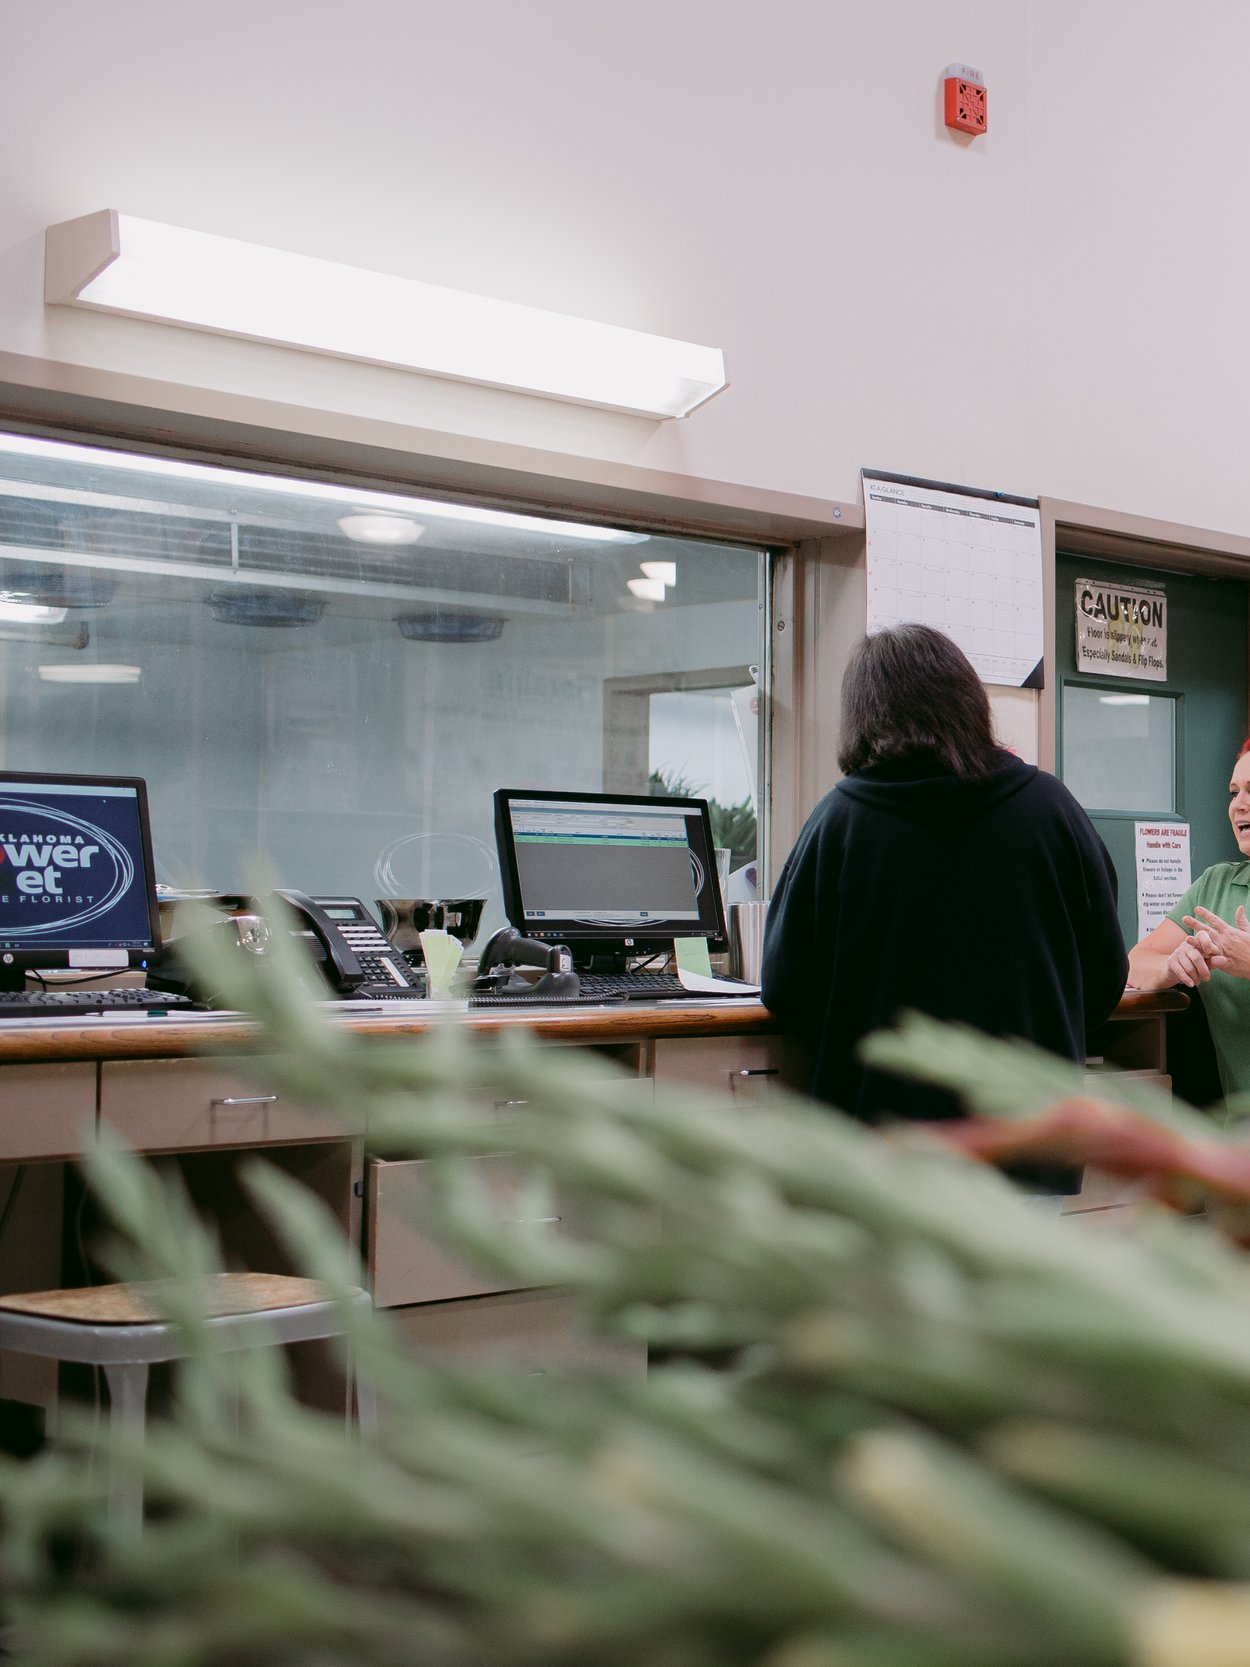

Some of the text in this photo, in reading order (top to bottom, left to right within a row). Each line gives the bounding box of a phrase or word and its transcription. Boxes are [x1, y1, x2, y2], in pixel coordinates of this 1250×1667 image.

[962, 68, 981, 80] FIRE
[1081, 589, 1163, 629] CAUTION
[1087, 626, 1103, 639] Floor
[1104, 628, 1110, 640] is
[1110, 629, 1132, 646] slippery
[1082, 645, 1110, 663] Especially
[1111, 650, 1132, 664] Sandals
[1132, 653, 1137, 665] &
[1138, 654, 1147, 669] Flip
[1139, 828, 1187, 837] FLOWERS ARE FRAGILE
[1146, 841, 1182, 849] Handle with Care
[0, 844, 100, 868] wer
[20, 895, 94, 904] FLORIST
